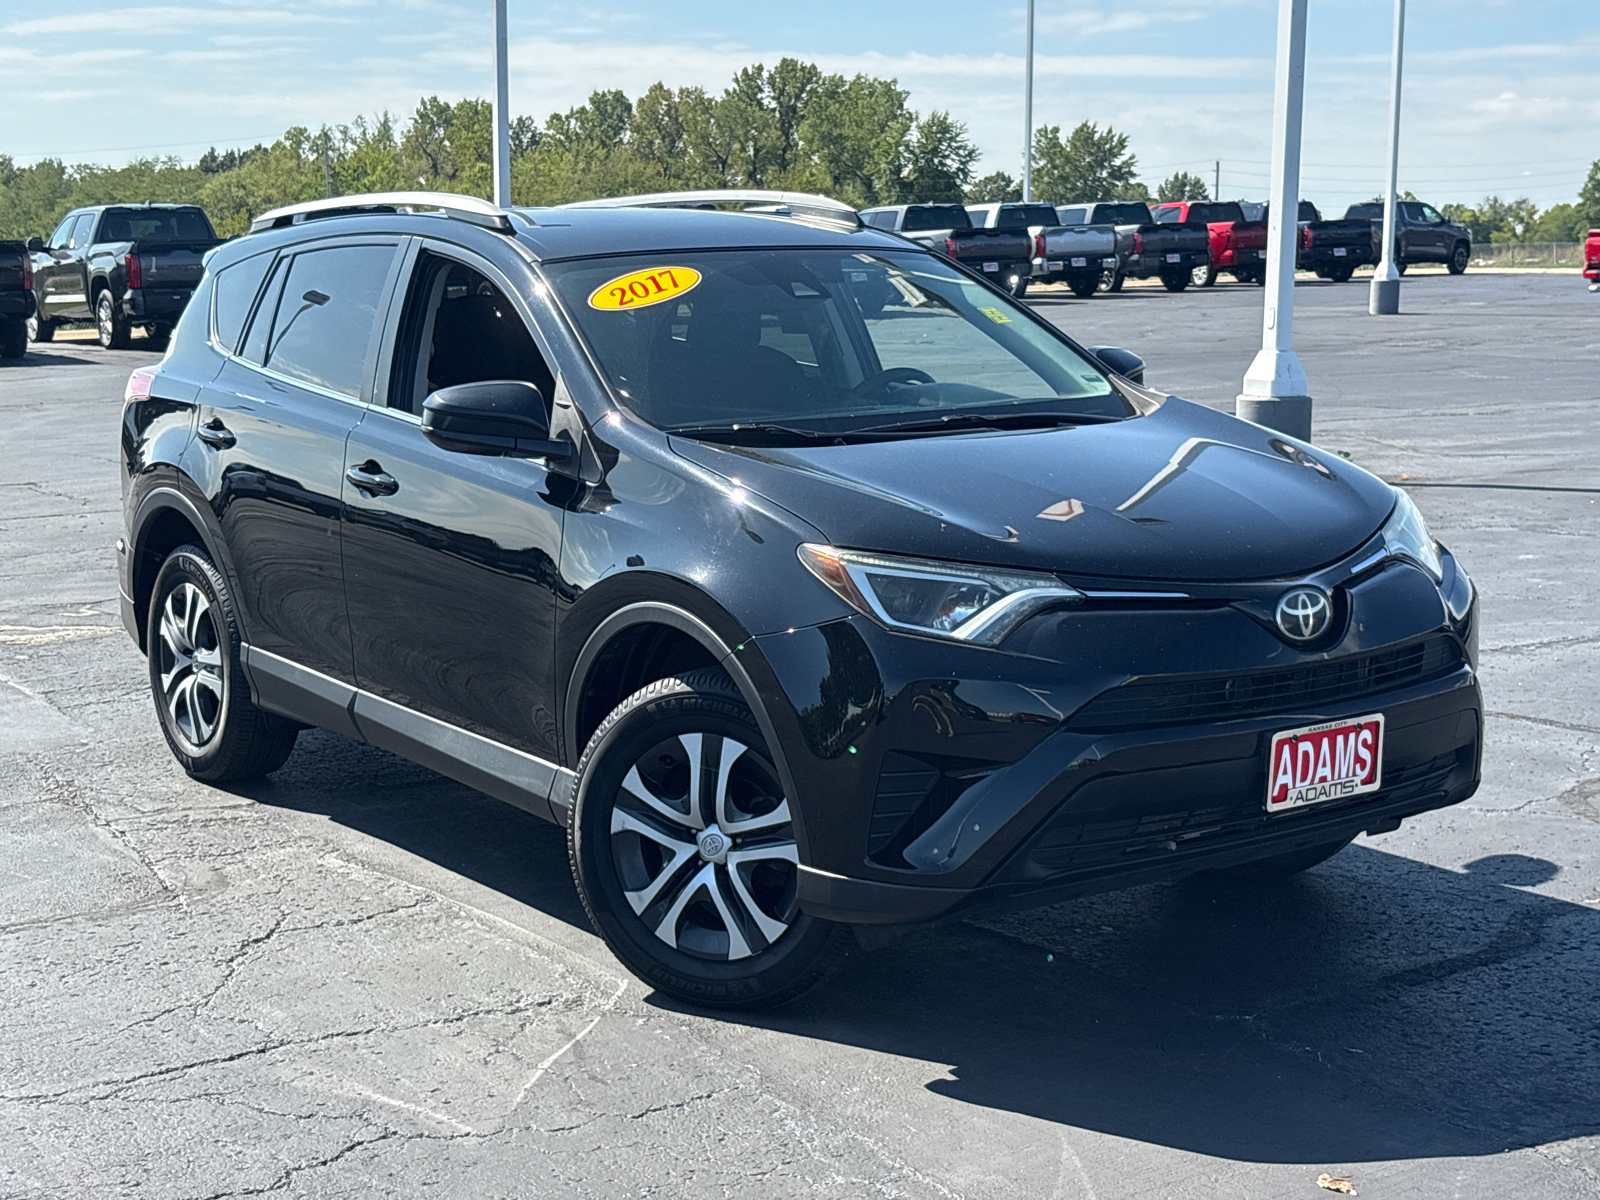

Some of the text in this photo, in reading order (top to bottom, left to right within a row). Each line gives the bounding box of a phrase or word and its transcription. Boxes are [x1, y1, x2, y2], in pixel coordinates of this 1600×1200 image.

[609, 269, 680, 307] 2017
[1308, 720, 1348, 732] KANSAS CITY
[1272, 728, 1373, 797] ADAMS
[1293, 779, 1355, 805] ADAMS
